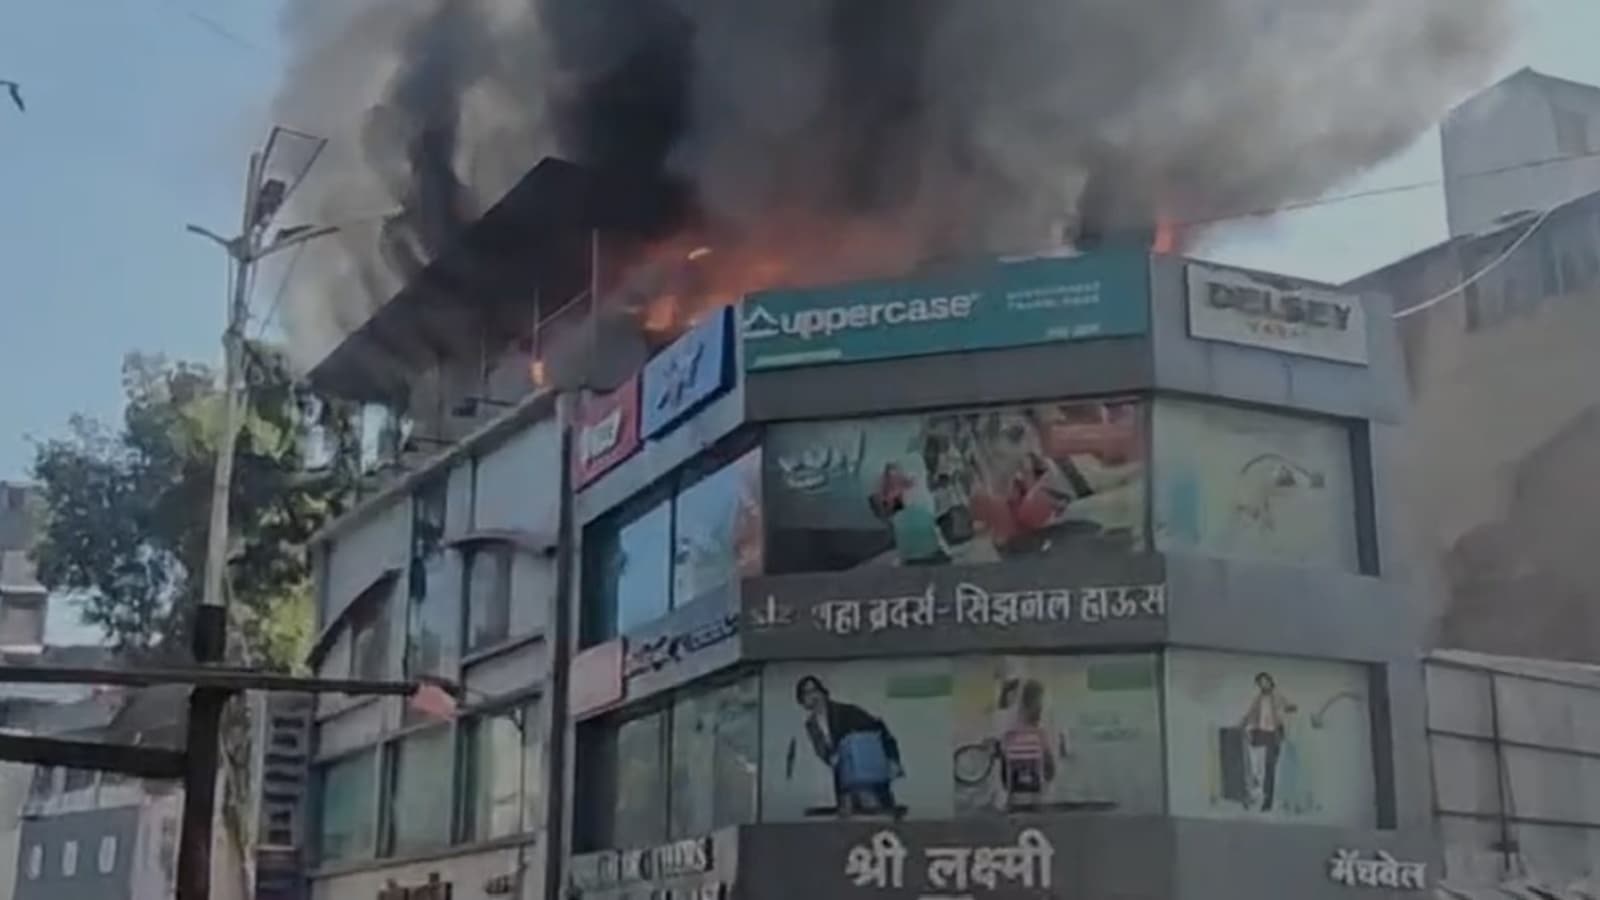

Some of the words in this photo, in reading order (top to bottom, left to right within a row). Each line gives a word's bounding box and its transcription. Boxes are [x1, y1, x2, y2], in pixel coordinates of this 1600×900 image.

[780, 294, 974, 339] uppercase
[845, 830, 908, 888] श्री
[924, 828, 1055, 890] लक्ष्मी
